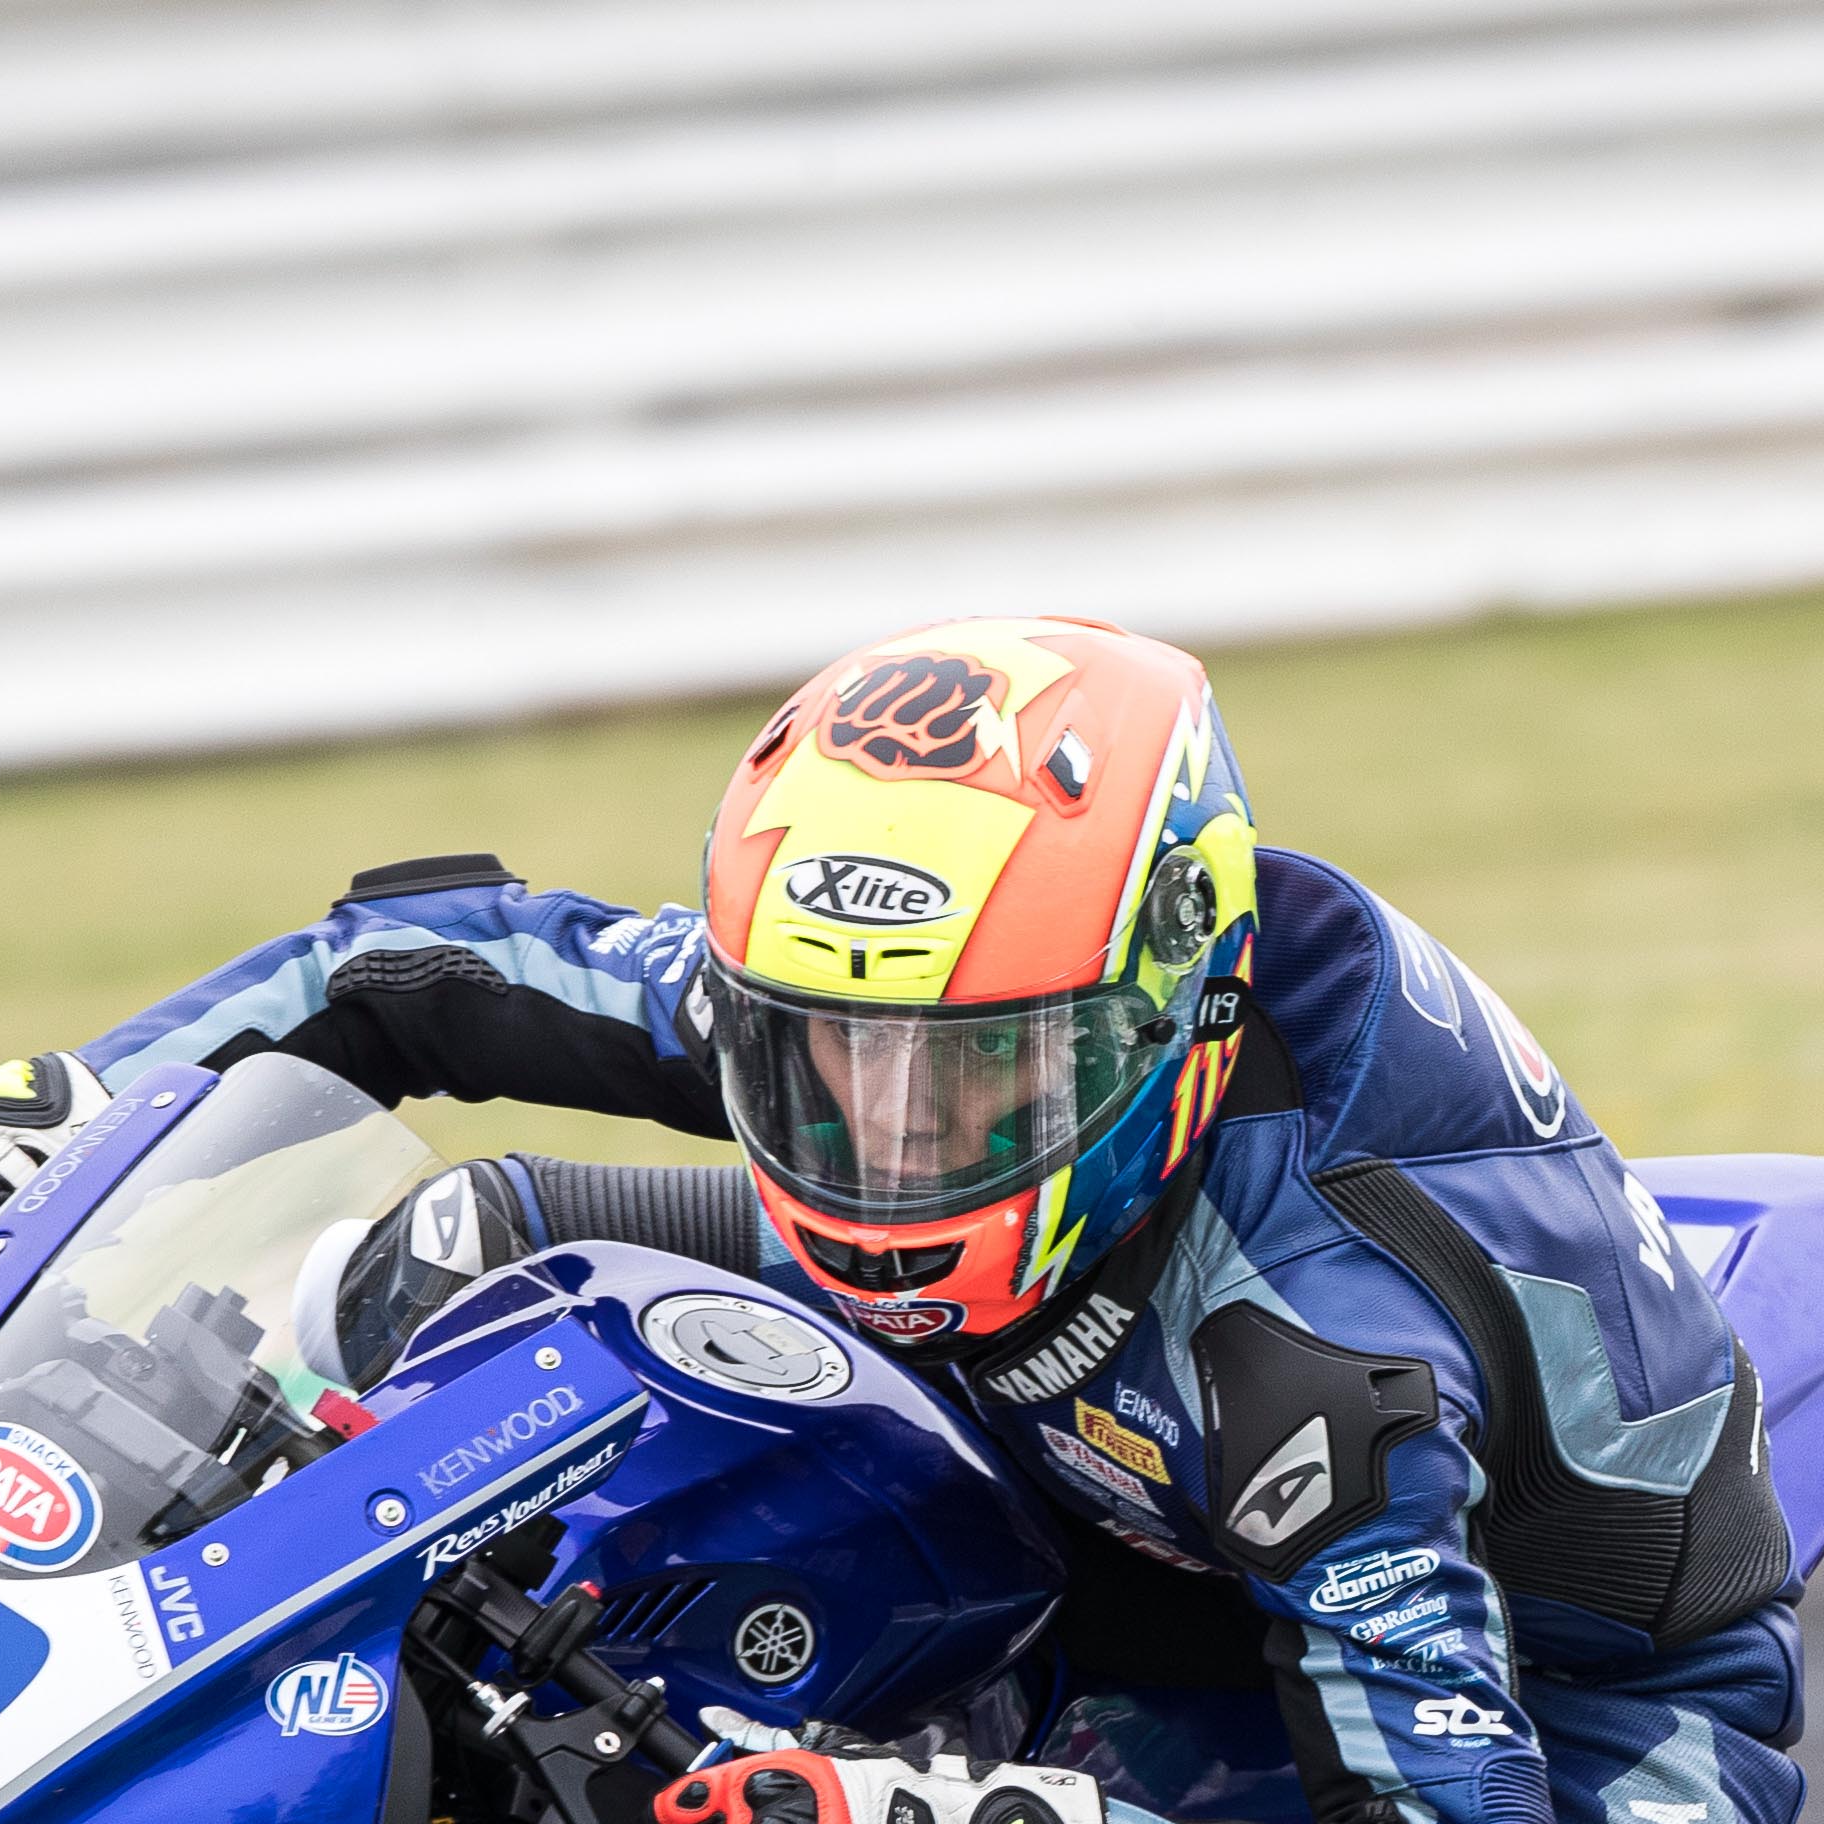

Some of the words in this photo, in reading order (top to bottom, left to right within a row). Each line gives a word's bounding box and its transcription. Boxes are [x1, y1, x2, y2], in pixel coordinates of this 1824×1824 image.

[798, 860, 932, 915] X-lite
[988, 1293, 1134, 1404] YAMAHA
[9, 1430, 72, 1478] SNACK
[417, 1386, 581, 1497] KENWOOD
[416, 1513, 500, 1581] Revs
[500, 1482, 557, 1533] Your
[557, 1442, 618, 1493] Heart
[150, 1565, 205, 1643] JVC
[1319, 1550, 1433, 1605] domino
[108, 1575, 158, 1680] KENWOOD
[1350, 1593, 1450, 1642] GBRacing
